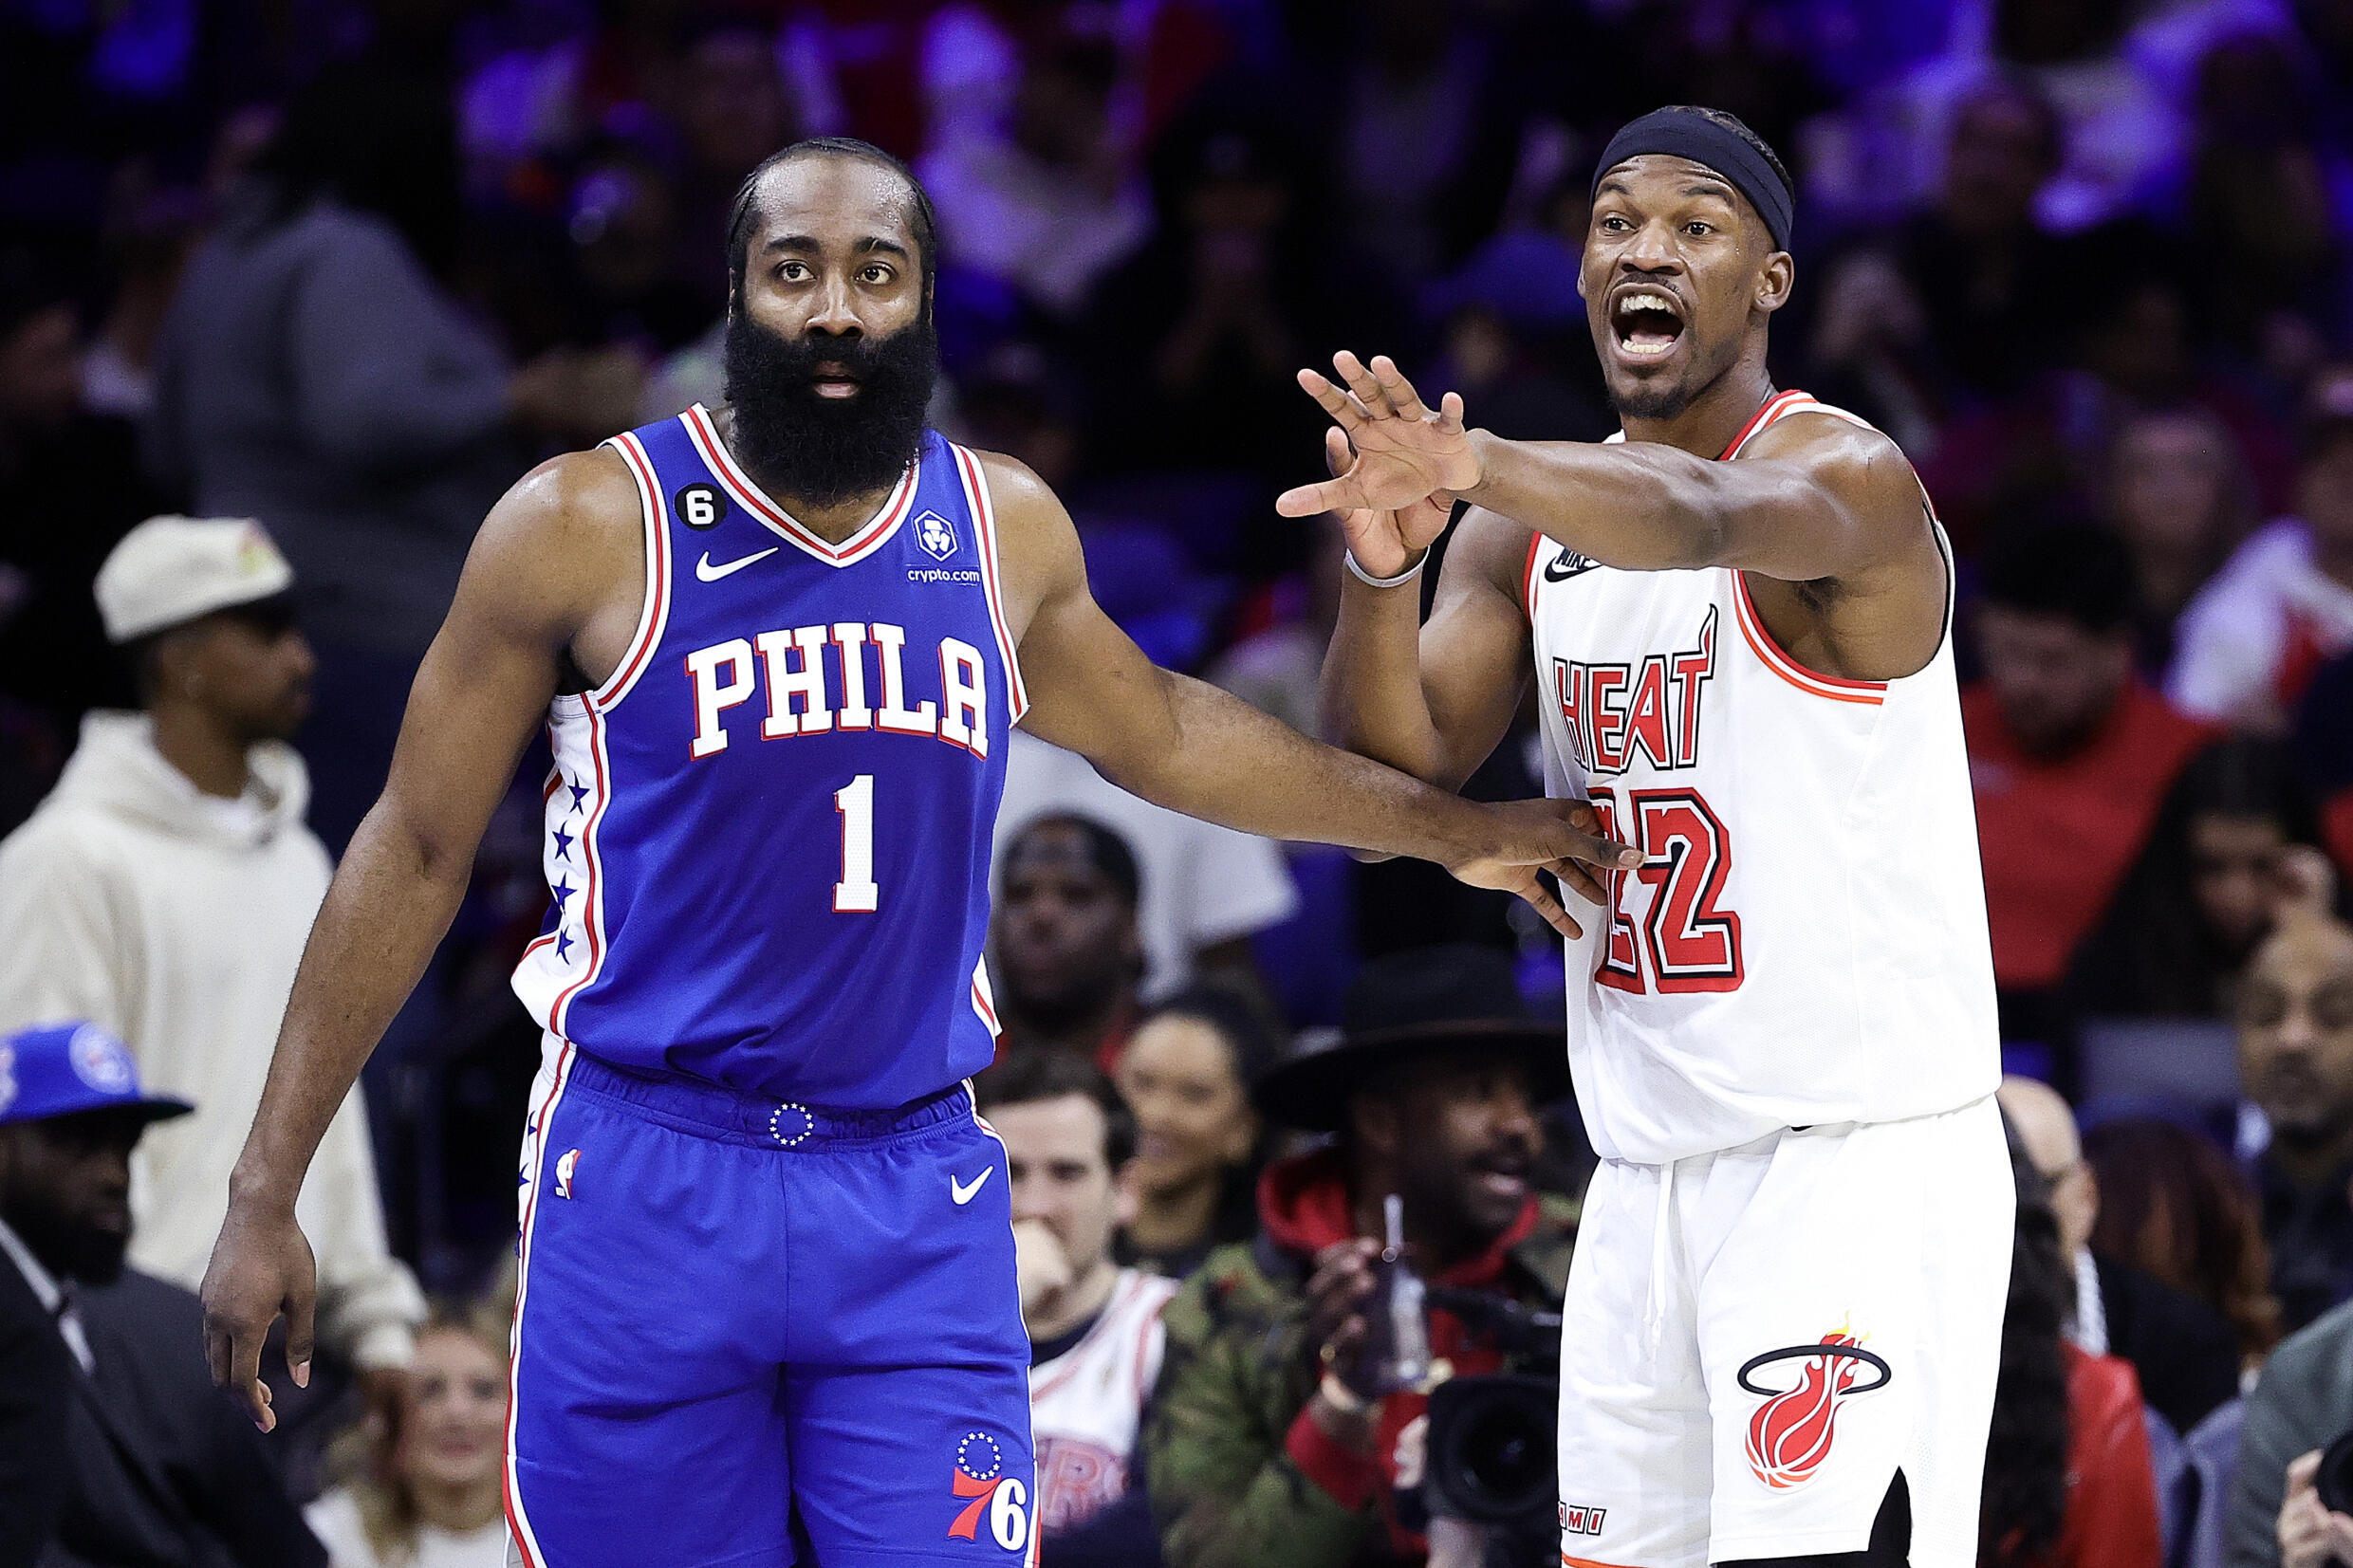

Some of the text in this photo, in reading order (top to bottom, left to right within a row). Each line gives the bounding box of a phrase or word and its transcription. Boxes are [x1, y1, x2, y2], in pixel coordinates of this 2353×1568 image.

[684, 489, 715, 526] 6
[907, 567, 980, 583] crypto.com
[684, 621, 990, 761] PHILA
[1552, 603, 1719, 776] HEAT
[831, 774, 879, 913] 1
[947, 1466, 1028, 1552] 76
